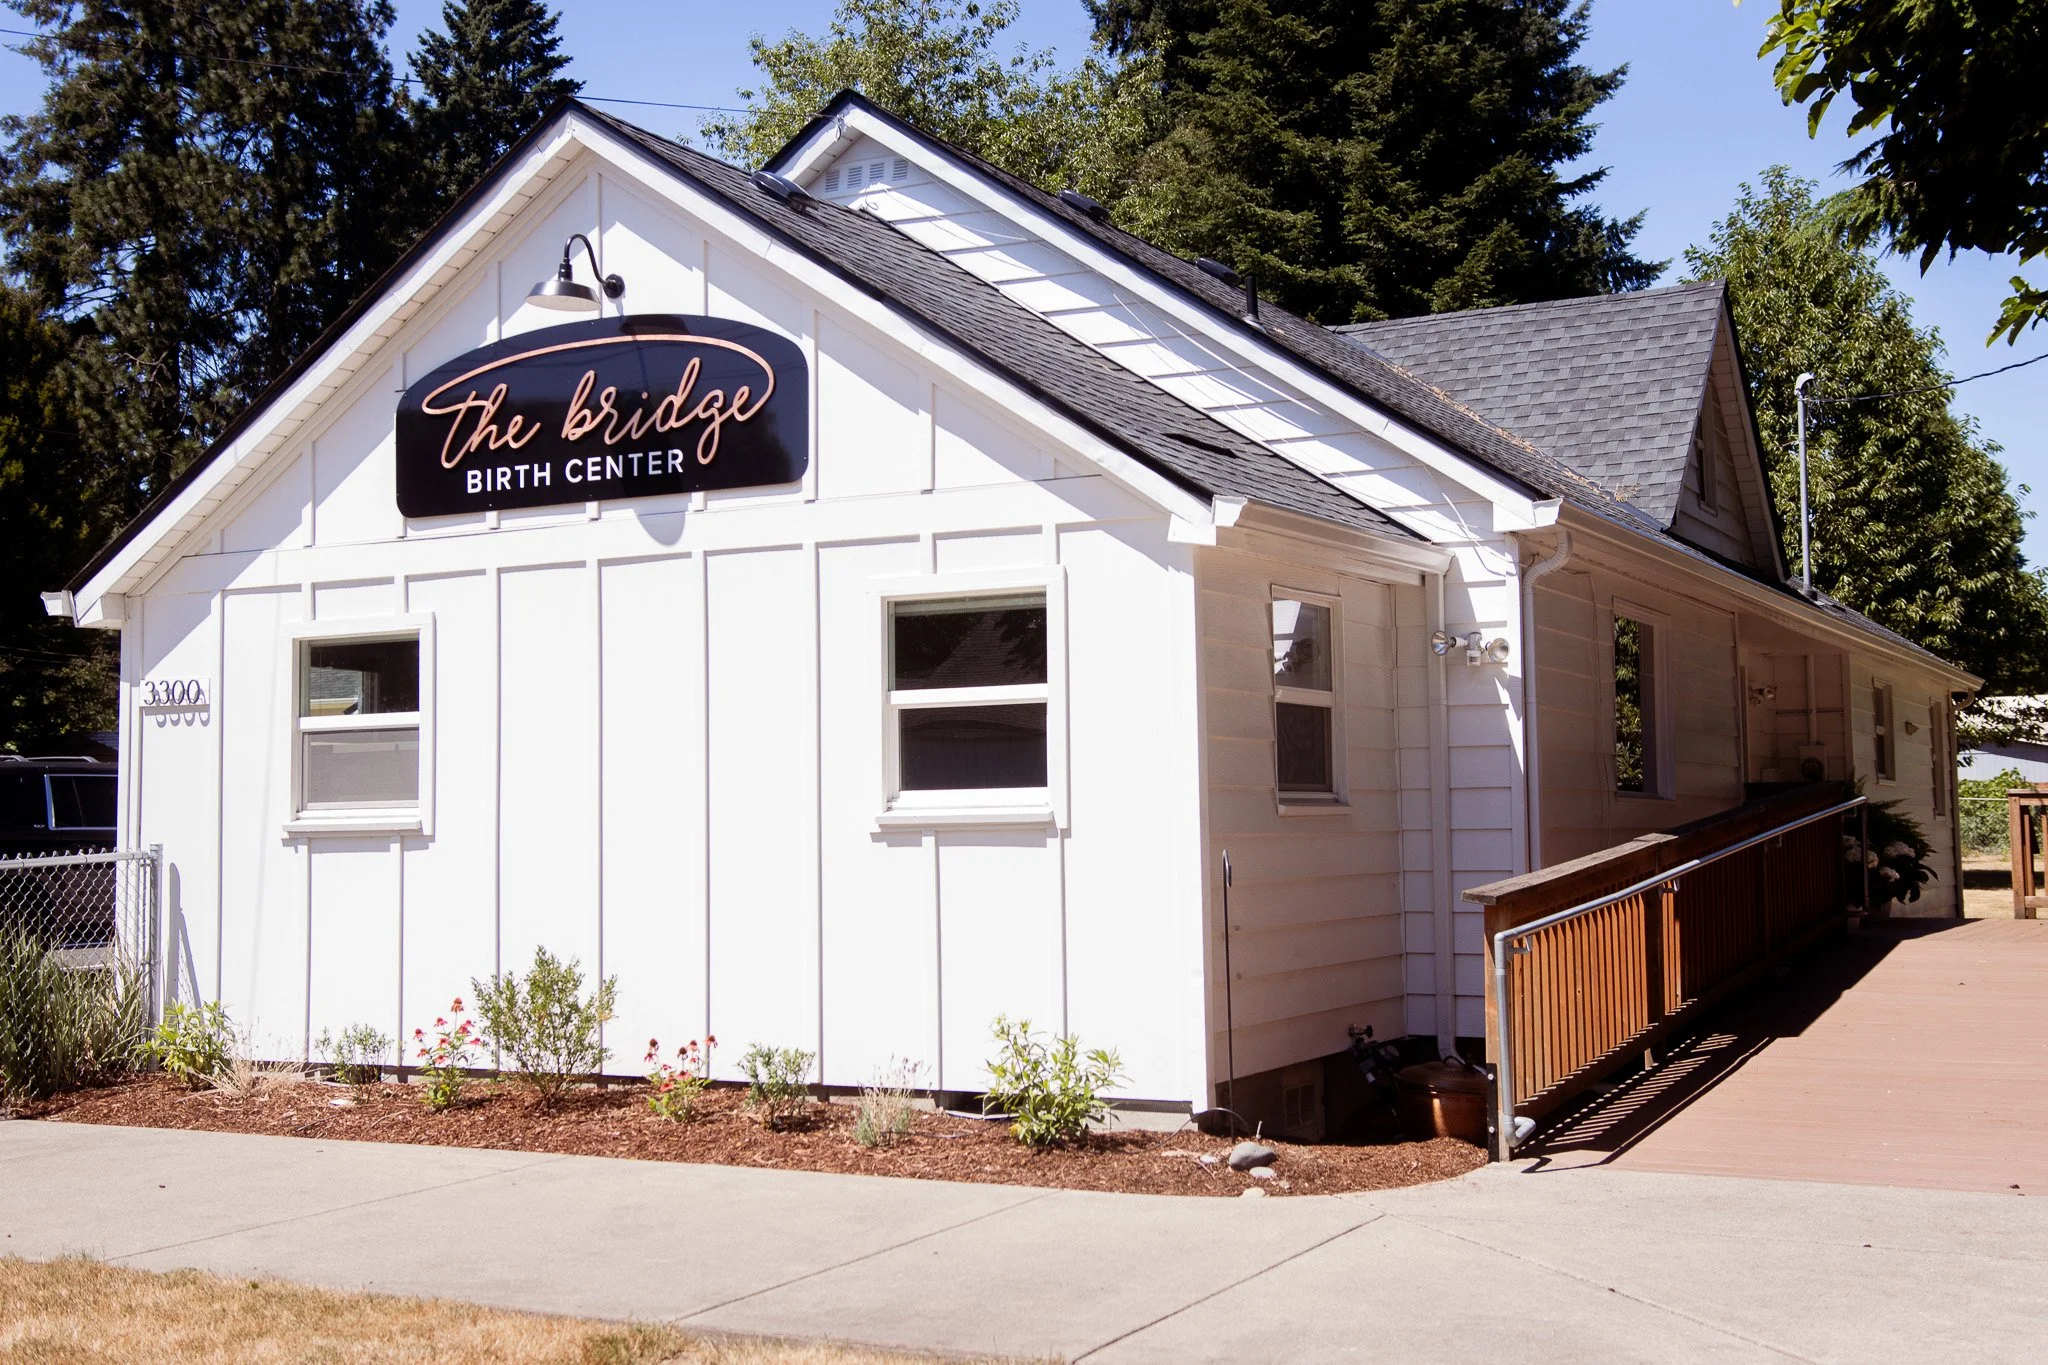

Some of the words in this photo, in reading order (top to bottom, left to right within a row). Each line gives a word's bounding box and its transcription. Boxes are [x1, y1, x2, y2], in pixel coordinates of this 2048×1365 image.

[561, 357, 757, 465] bridge
[466, 462, 552, 494] BIRTH
[565, 448, 684, 483] CENTER
[143, 679, 201, 705] 3300
